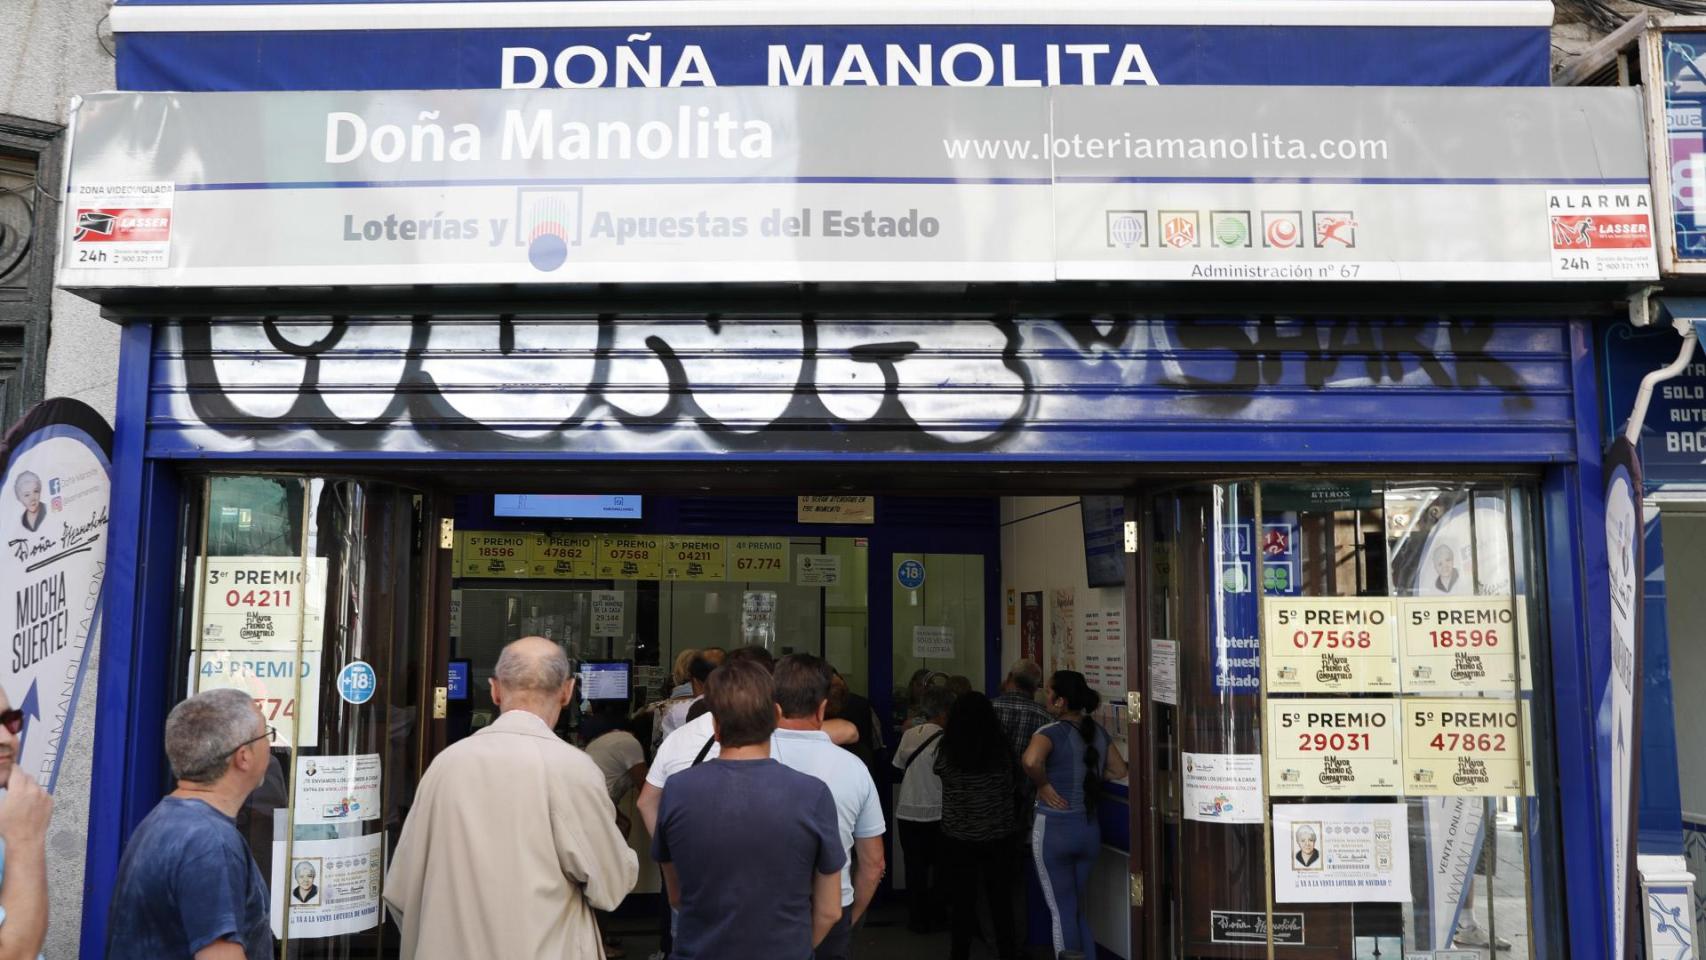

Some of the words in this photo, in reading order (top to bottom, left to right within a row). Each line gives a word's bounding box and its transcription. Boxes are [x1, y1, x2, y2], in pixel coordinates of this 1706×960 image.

[501, 32, 717, 88] DOÑA
[768, 43, 1160, 87] MANOLITA
[325, 110, 481, 164] Doña
[501, 105, 773, 161] Manolita
[943, 131, 1389, 160] www.loteriamanolita.com
[80, 185, 105, 195] ZONA
[106, 184, 173, 195] VIDEOVIGILADA
[1549, 194, 1648, 209] ALARMA
[120, 217, 169, 229] LASSER
[343, 212, 479, 241] Loterías
[489, 216, 508, 248] y
[590, 210, 762, 246] Apuestas
[773, 209, 811, 238] del
[823, 209, 940, 238] Estado
[1599, 223, 1647, 234] LASSER
[79, 249, 107, 262] 24h
[1560, 257, 1590, 270] 24h
[1191, 261, 1314, 280] Administración
[1340, 264, 1361, 279] 67
[1663, 386, 1704, 399] SOLO
[484, 537, 523, 546] PREMIO
[550, 539, 590, 547] PREMIO
[616, 540, 657, 549] PREMIO
[681, 542, 720, 550] PREMIO
[748, 542, 782, 550] PREMIO
[479, 547, 515, 557] 18596
[543, 548, 582, 558] 47862
[610, 550, 649, 560] 07568
[678, 551, 711, 561] 04211
[737, 558, 781, 570] 67.774
[234, 569, 310, 585] PREMIO
[16, 570, 67, 630] MUCHA
[225, 589, 292, 608] 04211
[1278, 609, 1297, 625] 5º
[1304, 608, 1385, 626] PREMIO
[1411, 609, 1430, 625] 5º
[1437, 608, 1513, 625] PREMIO
[11, 608, 69, 675] SUERTE!
[1293, 630, 1371, 649] 07568
[1429, 629, 1498, 648] 18596
[201, 660, 223, 679] 4º
[230, 660, 310, 679] PREMIO
[343, 672, 369, 689] +18
[1216, 674, 1260, 687] Estado
[1281, 712, 1300, 729] 5º
[1307, 711, 1386, 728] PREMIO
[1414, 712, 1434, 728] 5º
[1441, 711, 1519, 728] PREMIO
[1298, 733, 1371, 751] 29031
[1430, 732, 1506, 752] 47862
[1438, 839, 1454, 875] VENTA
